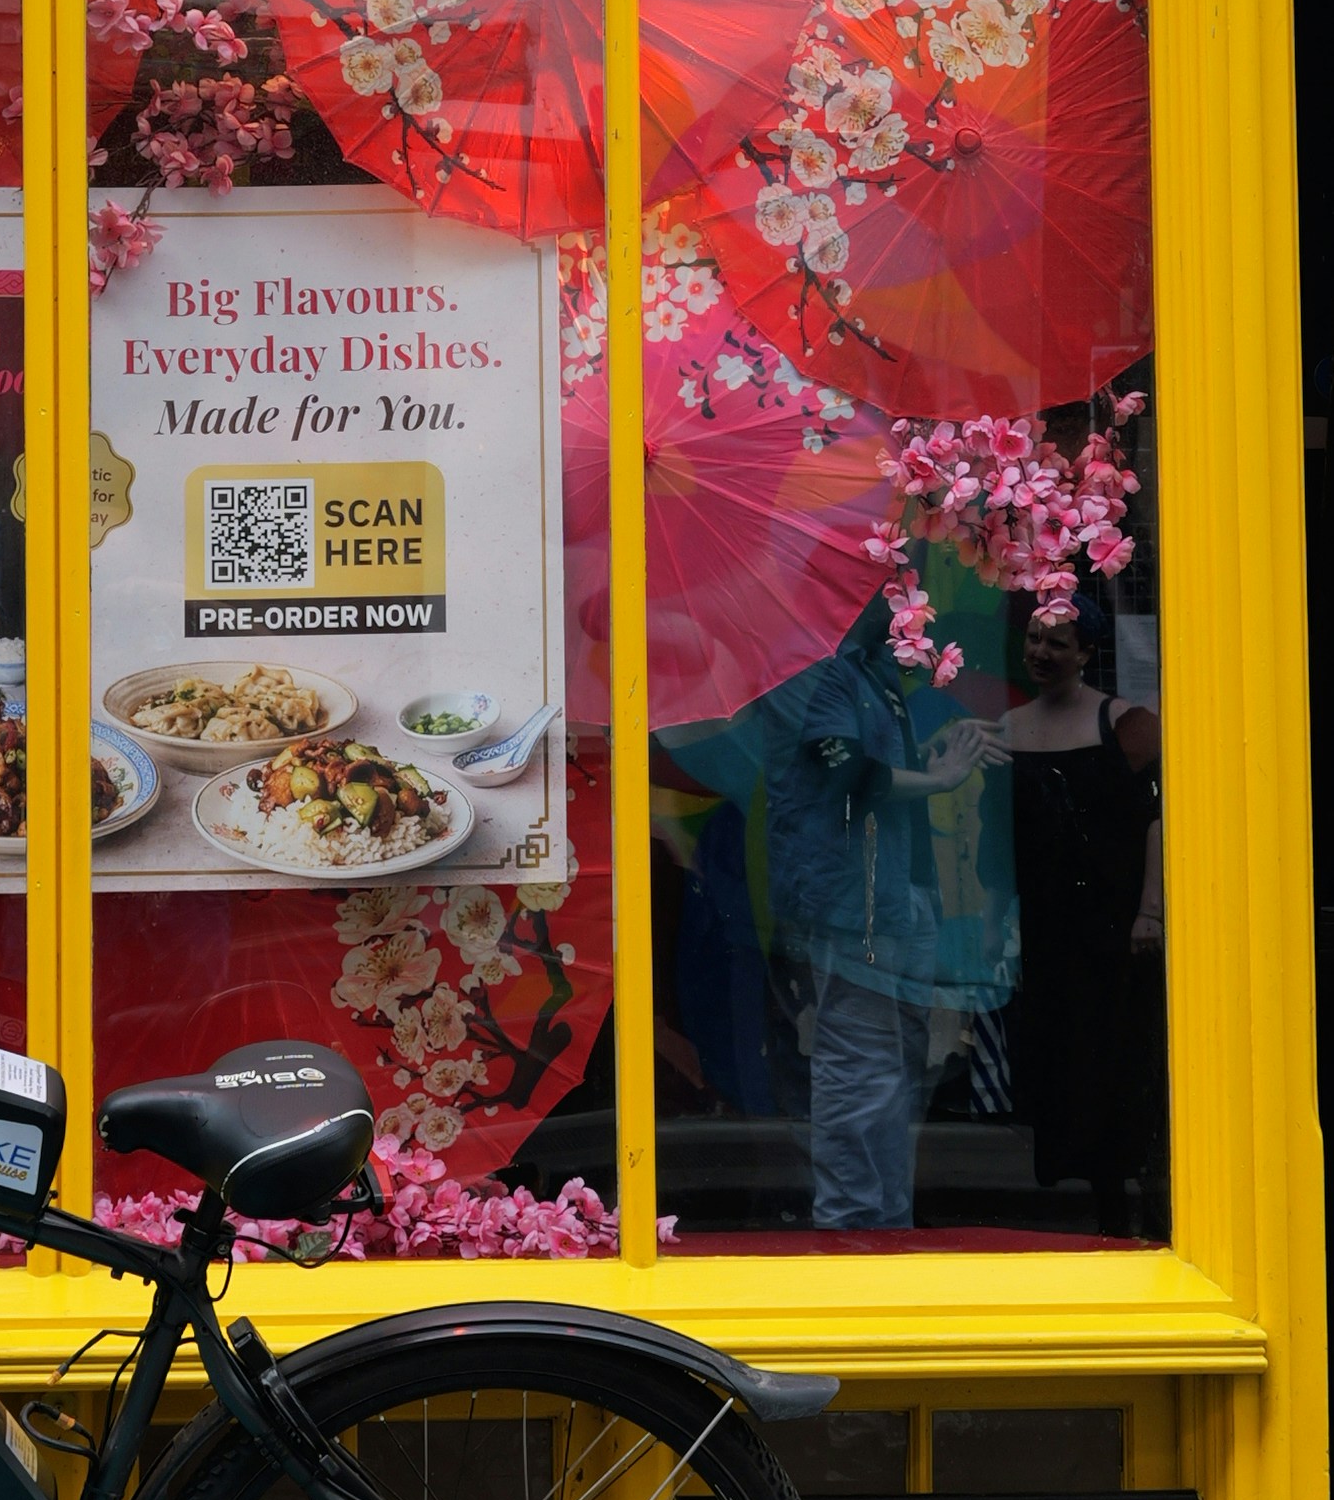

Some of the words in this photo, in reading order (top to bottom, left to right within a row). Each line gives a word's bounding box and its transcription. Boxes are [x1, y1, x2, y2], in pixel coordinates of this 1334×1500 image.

[167, 279, 239, 325] Big
[253, 277, 458, 316] Flavours.
[123, 335, 327, 382] Everyday
[339, 332, 502, 372] Dishes.
[154, 396, 279, 436] Made
[291, 394, 360, 442] for
[376, 395, 466, 432] You.
[324, 498, 423, 528] SCAN
[325, 537, 423, 567] HERE
[198, 606, 359, 632] PRE-ORDER
[365, 603, 434, 628] NOW
